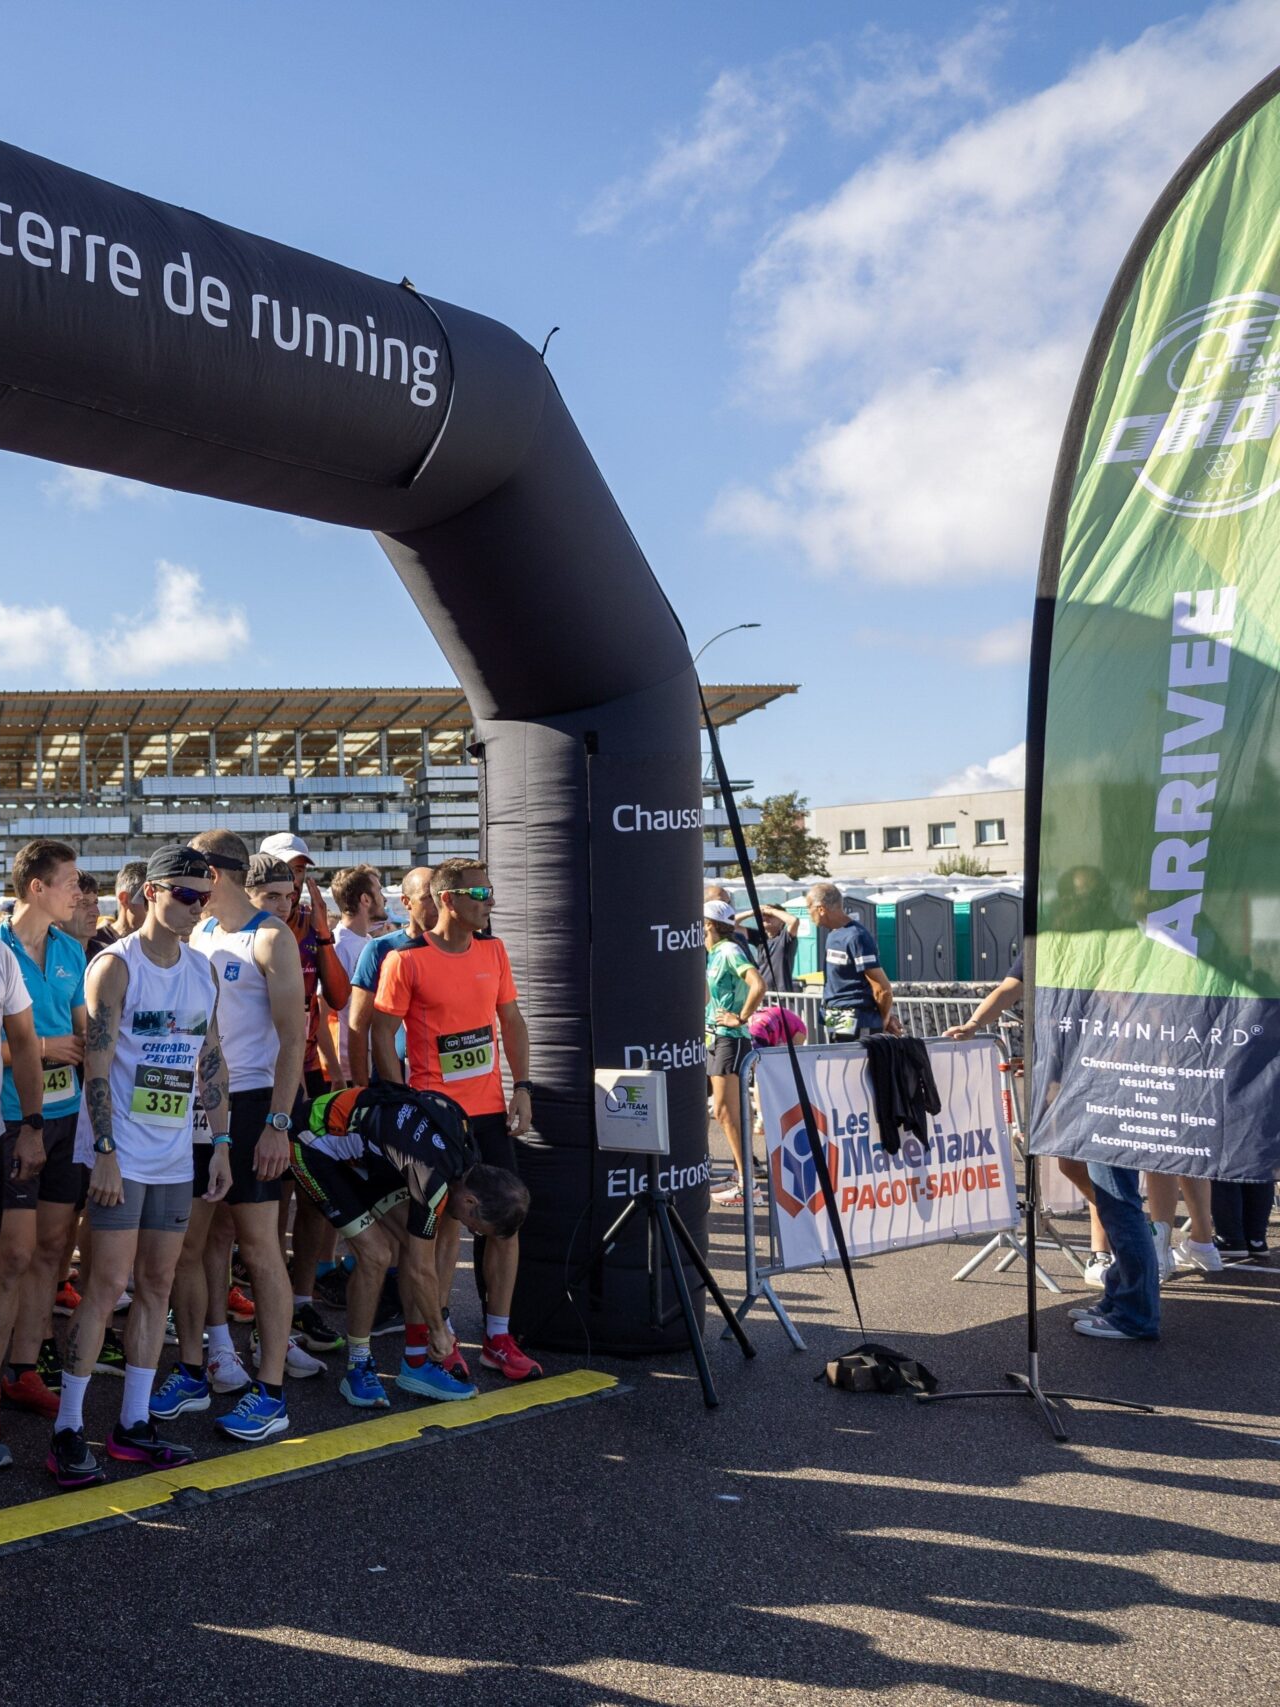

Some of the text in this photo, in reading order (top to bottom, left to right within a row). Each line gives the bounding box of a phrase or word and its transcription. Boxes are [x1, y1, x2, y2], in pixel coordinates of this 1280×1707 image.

[163, 252, 231, 328] de
[250, 294, 439, 408] running
[1146, 586, 1237, 959] ARRIVEE
[452, 1048, 486, 1069] 390
[1080, 1056, 1226, 1080] Chronomètrage sportif
[1119, 1077, 1176, 1092] résultats
[145, 1091, 183, 1115] 337
[1135, 1093, 1159, 1105] live
[831, 1108, 869, 1137] Les
[1086, 1102, 1217, 1127] Inscriptions en ligne
[1119, 1122, 1177, 1138] dossards
[841, 1123, 996, 1178] Matériaux
[1091, 1133, 1212, 1158] Accompagnement
[840, 1163, 1001, 1213] PAGOT-SAVOIE
